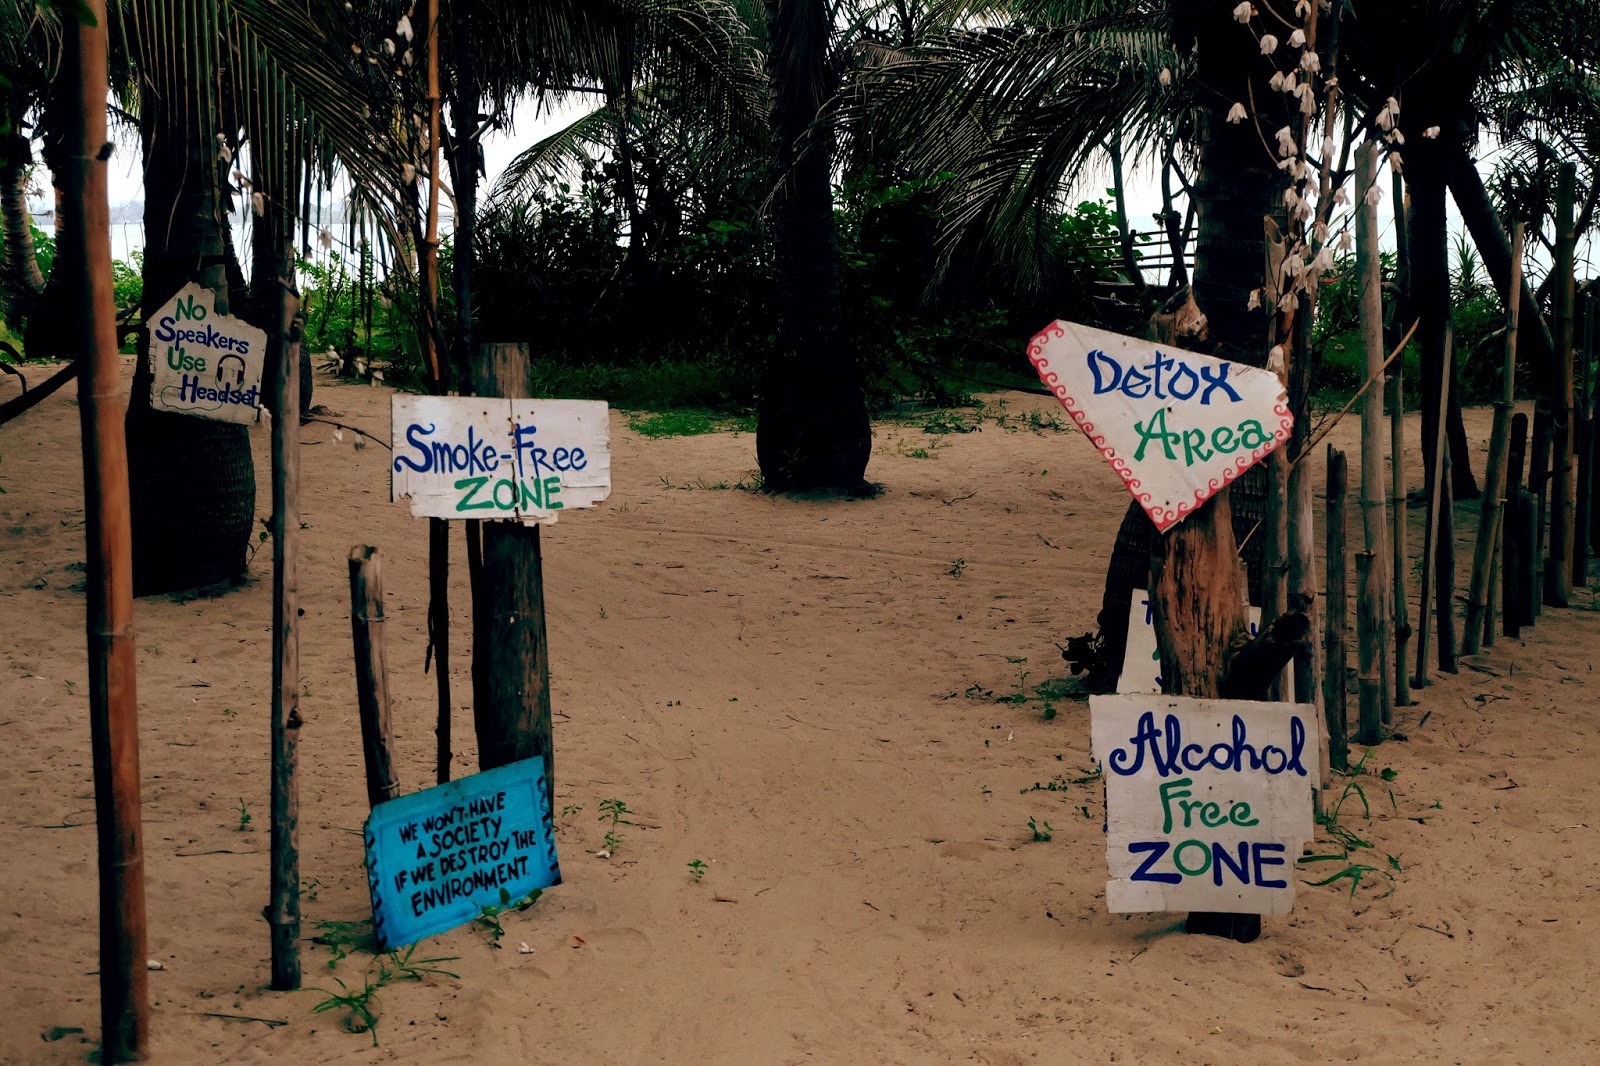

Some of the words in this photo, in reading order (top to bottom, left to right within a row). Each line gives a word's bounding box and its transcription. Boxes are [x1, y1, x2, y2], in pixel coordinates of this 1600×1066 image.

[175, 294, 207, 321] No
[155, 316, 249, 355] Speakers
[167, 345, 207, 372] Use
[180, 374, 261, 407] Headset
[1086, 349, 1244, 405] Detox
[1133, 407, 1274, 467] Area
[454, 476, 565, 512] ZONE
[1109, 711, 1307, 777] Alcohol
[398, 821, 419, 845] WE
[468, 791, 507, 818] HAVE
[1158, 777, 1260, 834] Free
[394, 870, 408, 893] IF
[410, 862, 436, 886] WE
[439, 837, 510, 877] DESTROY
[511, 829, 537, 850] THE
[416, 843, 427, 860] A
[429, 816, 503, 859] SOCIETY
[1128, 839, 1288, 889] ZONE
[410, 855, 531, 918] ENVIRONMENT.
